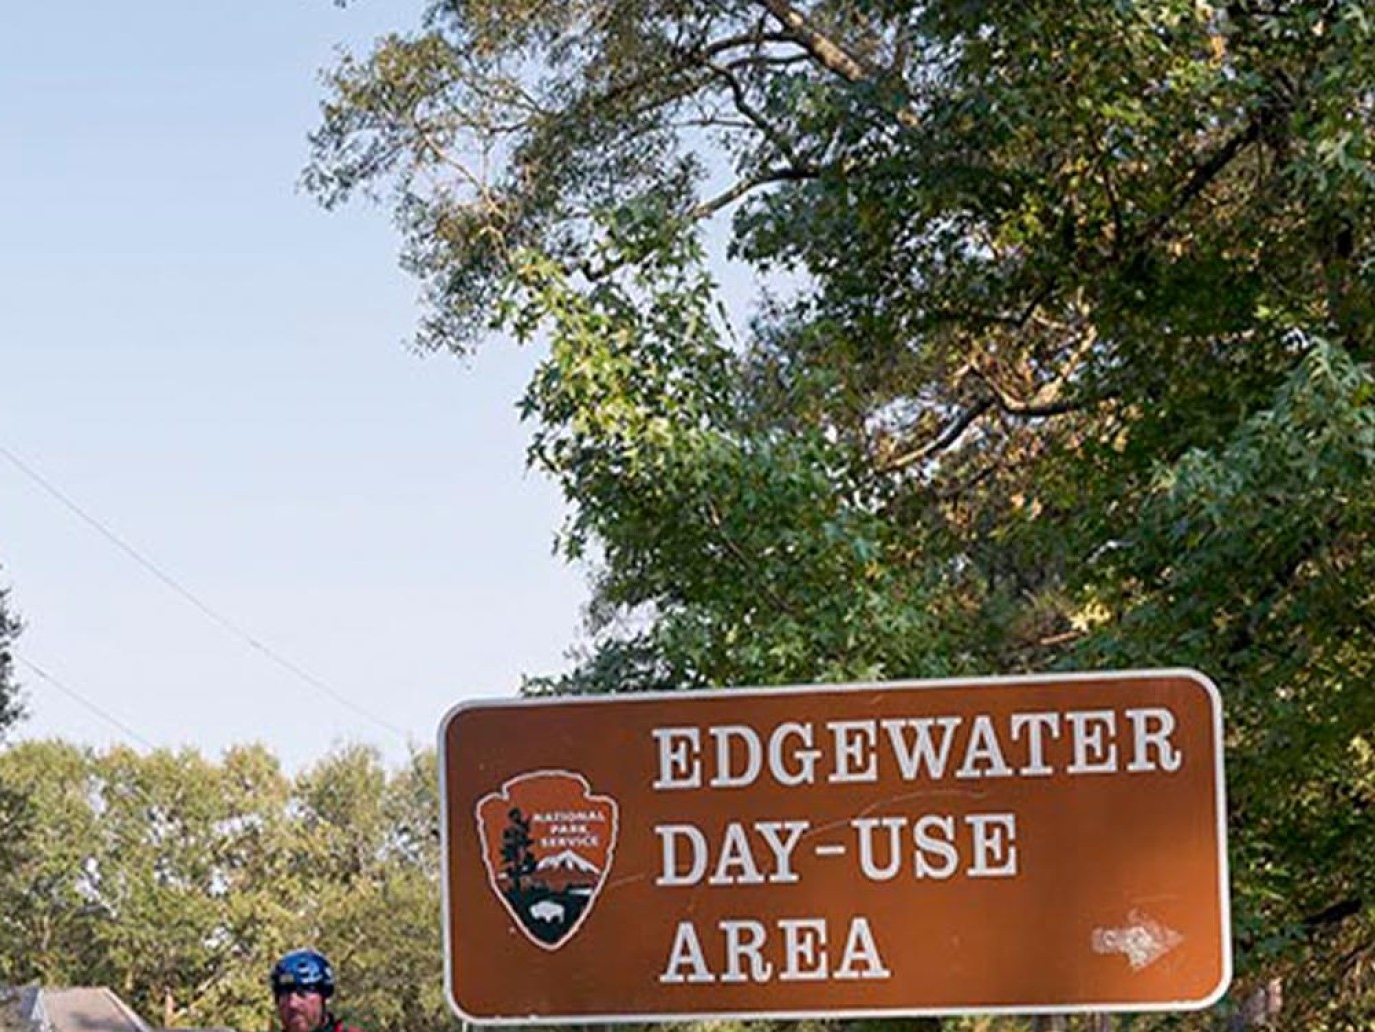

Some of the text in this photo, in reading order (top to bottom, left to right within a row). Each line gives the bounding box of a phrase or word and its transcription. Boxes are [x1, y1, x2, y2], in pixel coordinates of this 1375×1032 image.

[651, 707, 1182, 790] EDGEWATER
[533, 810, 605, 822] NATIONAL
[549, 824, 588, 834] PARK
[541, 836, 599, 848] SERVICE
[654, 813, 1017, 887] DAY-USE
[659, 917, 891, 983] AREA
